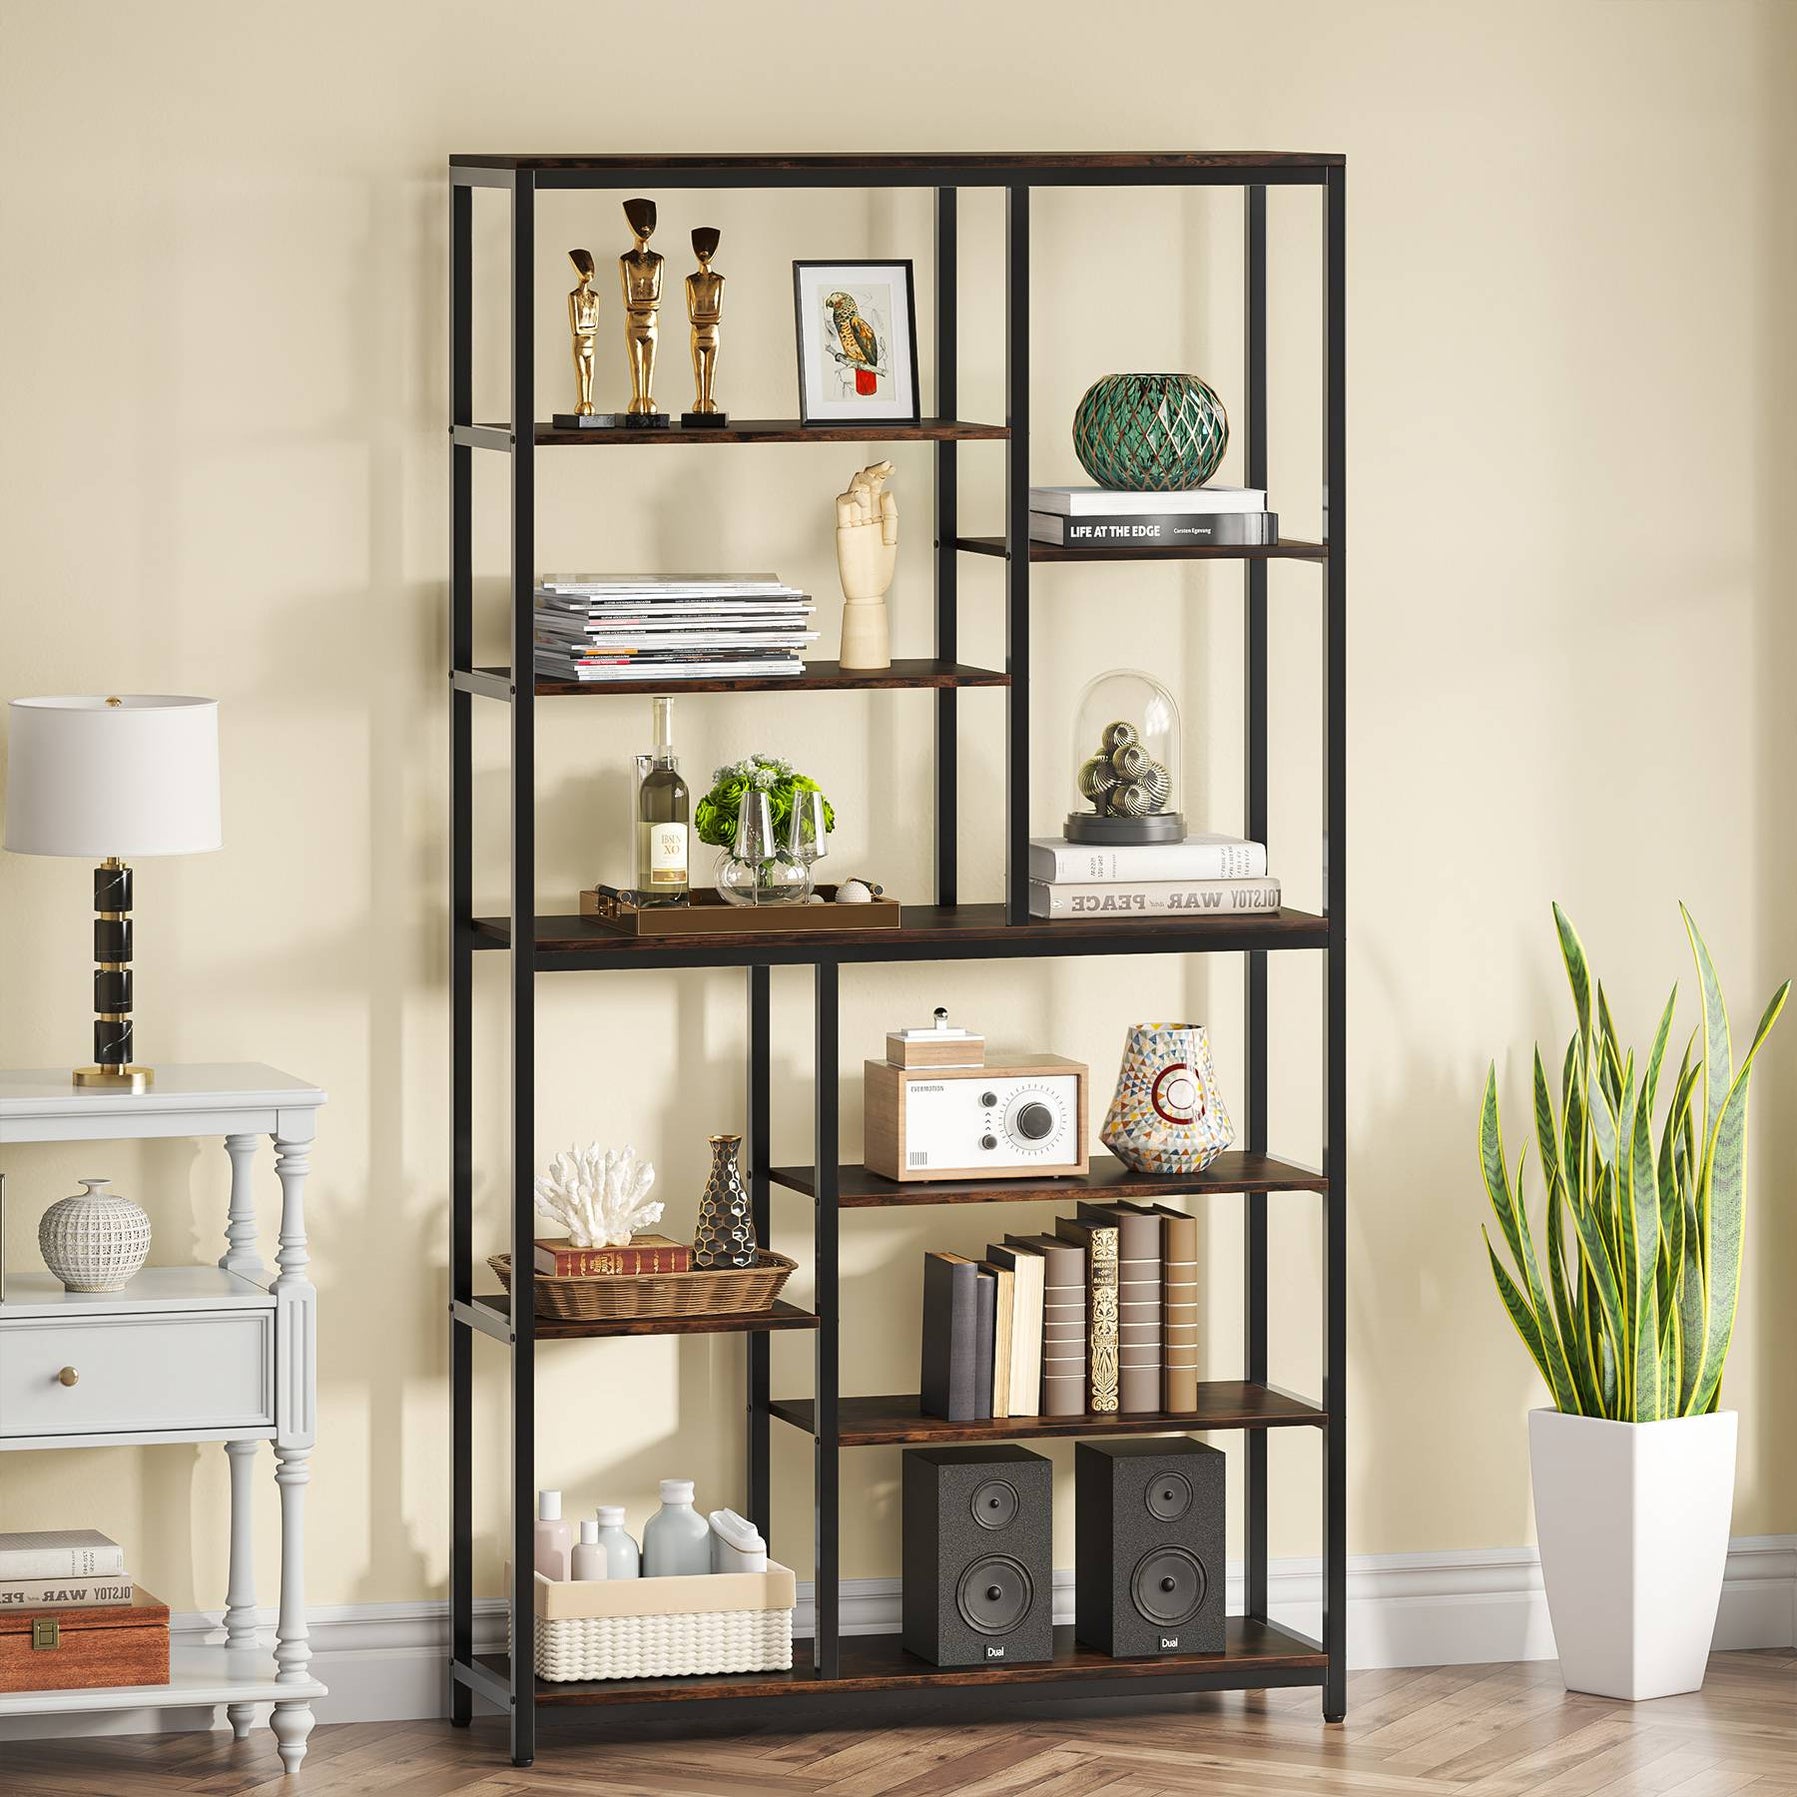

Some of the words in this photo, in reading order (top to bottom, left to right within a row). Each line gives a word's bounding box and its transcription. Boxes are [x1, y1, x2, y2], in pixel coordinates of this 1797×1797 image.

[1070, 526, 1092, 538] LIFE
[1093, 526, 1108, 538] AT
[1109, 525, 1131, 538] THE
[1132, 525, 1161, 537] EDGE
[664, 845, 680, 856] XO
[1161, 1637, 1178, 1648] Dual
[987, 1646, 1004, 1657] Dual
